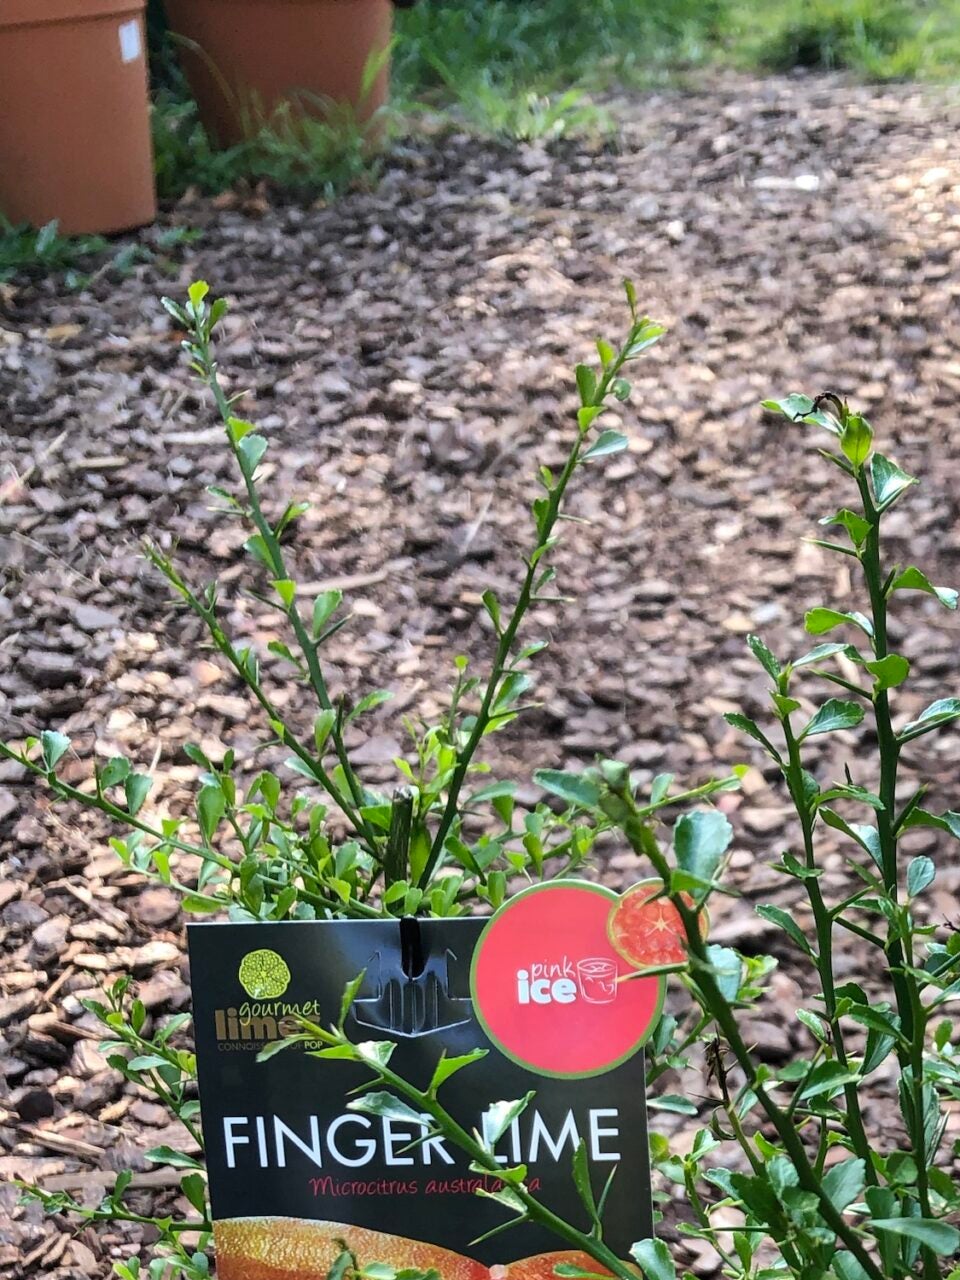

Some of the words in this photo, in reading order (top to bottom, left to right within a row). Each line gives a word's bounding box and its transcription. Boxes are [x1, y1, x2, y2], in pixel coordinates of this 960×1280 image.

[531, 955, 576, 983] pink
[517, 969, 577, 1005] ice
[239, 1000, 321, 1026] gourmet
[304, 1040, 323, 1049] POP
[223, 1113, 456, 1168] FINGER
[309, 1175, 417, 1197] Microcitrus
[426, 1173, 542, 1195] australaa
